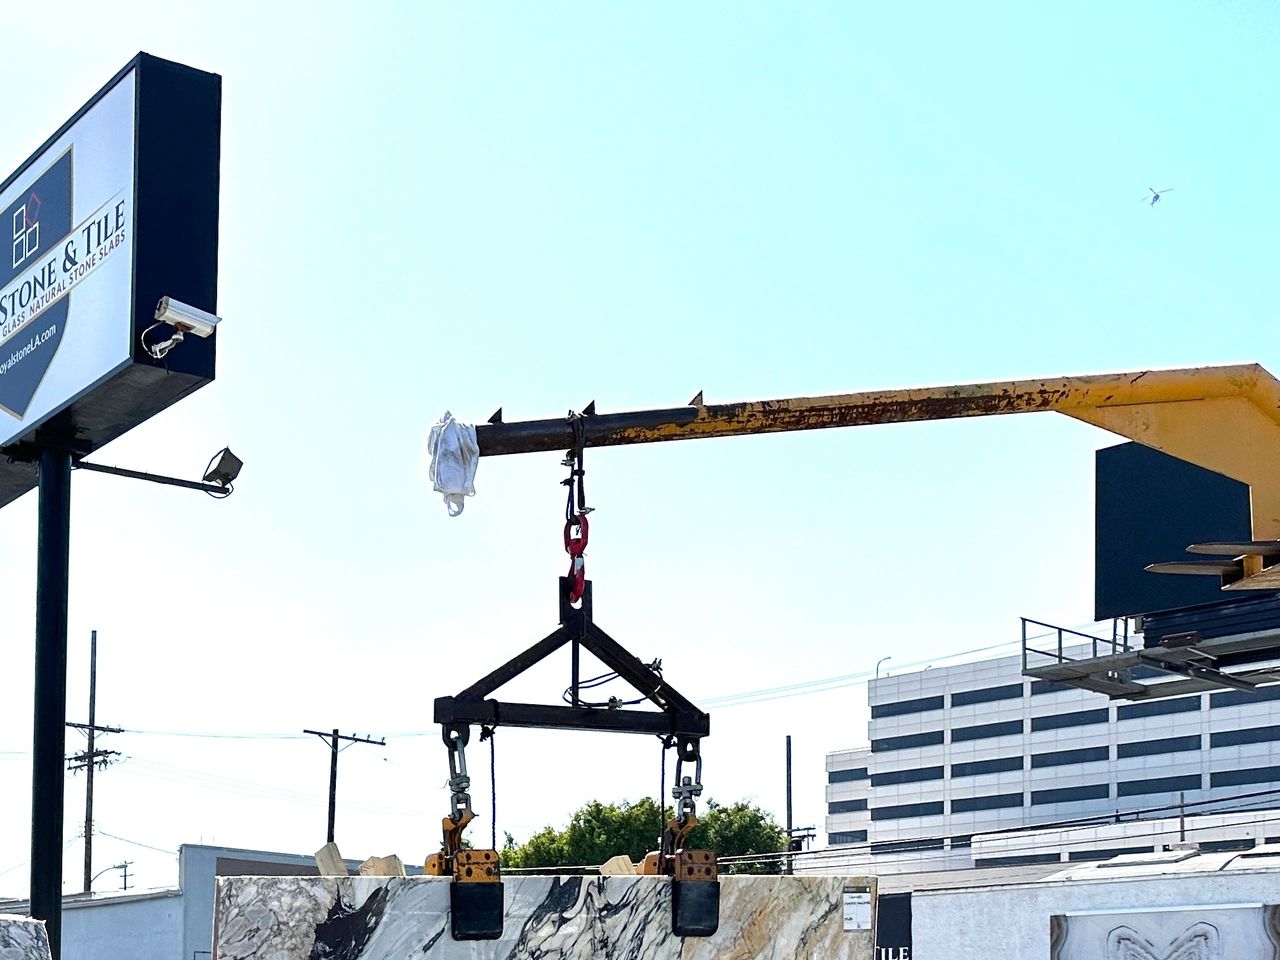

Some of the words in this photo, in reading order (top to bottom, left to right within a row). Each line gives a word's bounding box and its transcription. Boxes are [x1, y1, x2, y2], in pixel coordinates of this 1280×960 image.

[62, 239, 79, 273] &
[82, 199, 125, 257] TILE
[2, 311, 25, 338] GLASS
[29, 282, 66, 317] NATURAL
[69, 254, 97, 285] STONE
[99, 229, 126, 260] SLABS
[876, 946, 909, 960] ILE
